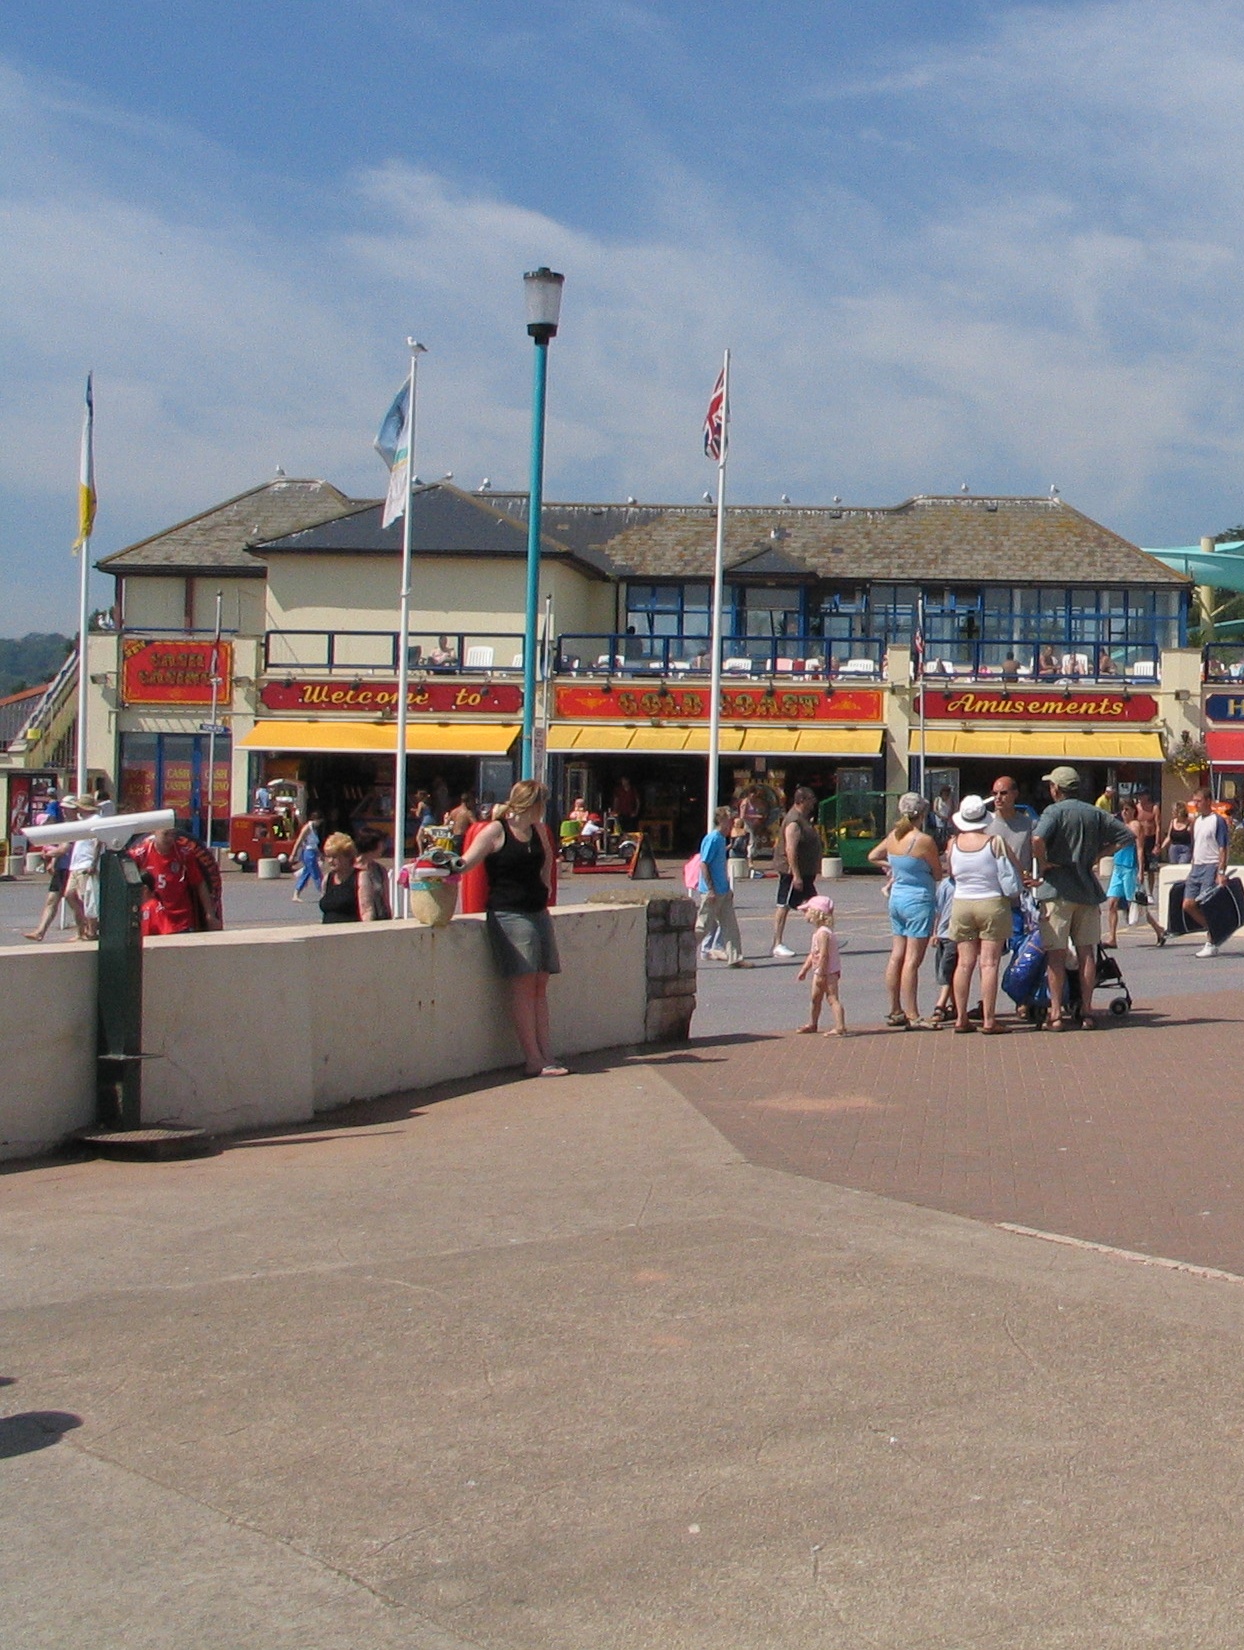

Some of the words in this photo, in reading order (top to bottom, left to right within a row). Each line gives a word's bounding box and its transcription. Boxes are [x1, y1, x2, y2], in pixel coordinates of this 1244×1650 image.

[303, 685, 429, 705] Welcome
[456, 688, 482, 706] to
[618, 693, 704, 715] GOLD
[947, 693, 1124, 715] Amusements
[158, 874, 167, 889] 5
